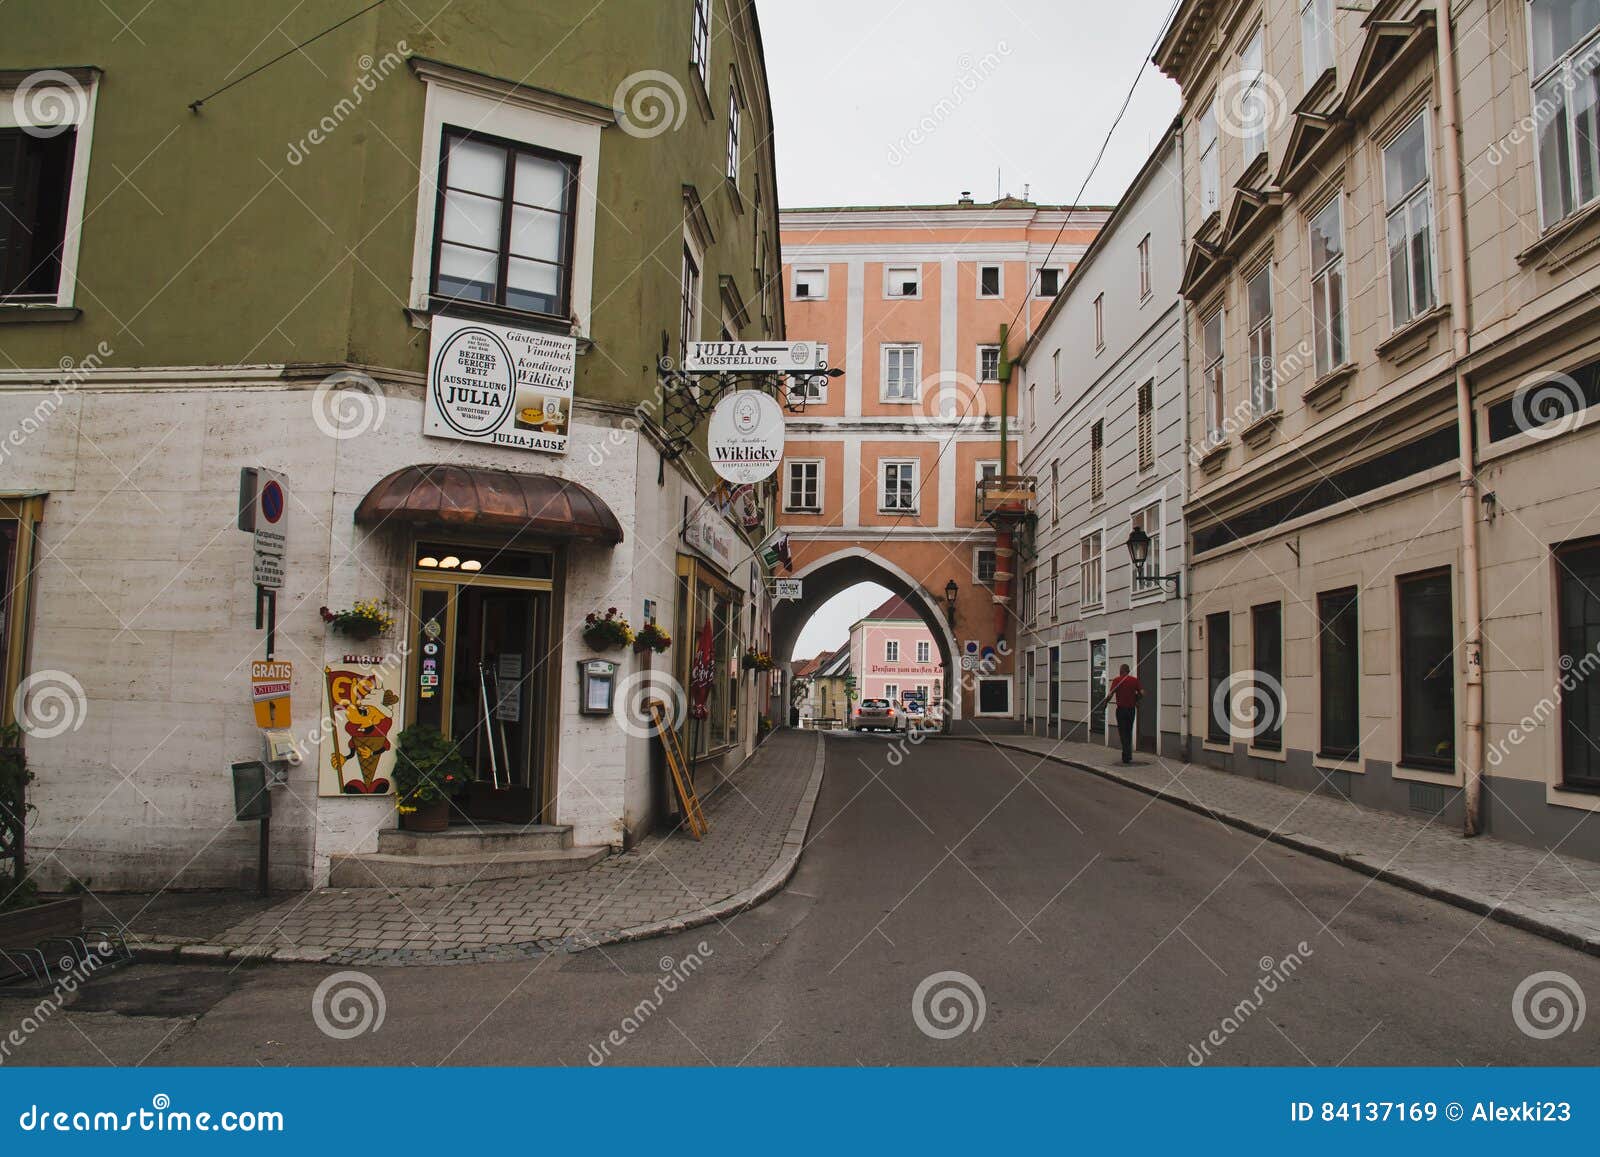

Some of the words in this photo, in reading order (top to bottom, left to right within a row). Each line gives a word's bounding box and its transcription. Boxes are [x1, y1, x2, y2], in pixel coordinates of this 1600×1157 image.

[506, 331, 573, 350] Gästezimmer
[459, 350, 496, 362] BEZIRKS
[526, 344, 572, 361] Vinothek
[694, 343, 748, 359] JULIA
[458, 357, 497, 370] GERICHT
[517, 357, 572, 375] Konditorei
[699, 356, 778, 365] AUSSTELLUNG
[465, 366, 488, 377] RETZ
[443, 375, 507, 391] AUSSTELLUNG
[517, 369, 572, 391] Wiklicky
[446, 386, 502, 408] JULIA
[456, 406, 490, 415] KONDITOREI
[461, 412, 485, 421] Wiklicky
[491, 432, 565, 451] JULIA-JAUSE
[715, 446, 778, 462] Wiklicky
[252, 663, 291, 678] GRATIS
